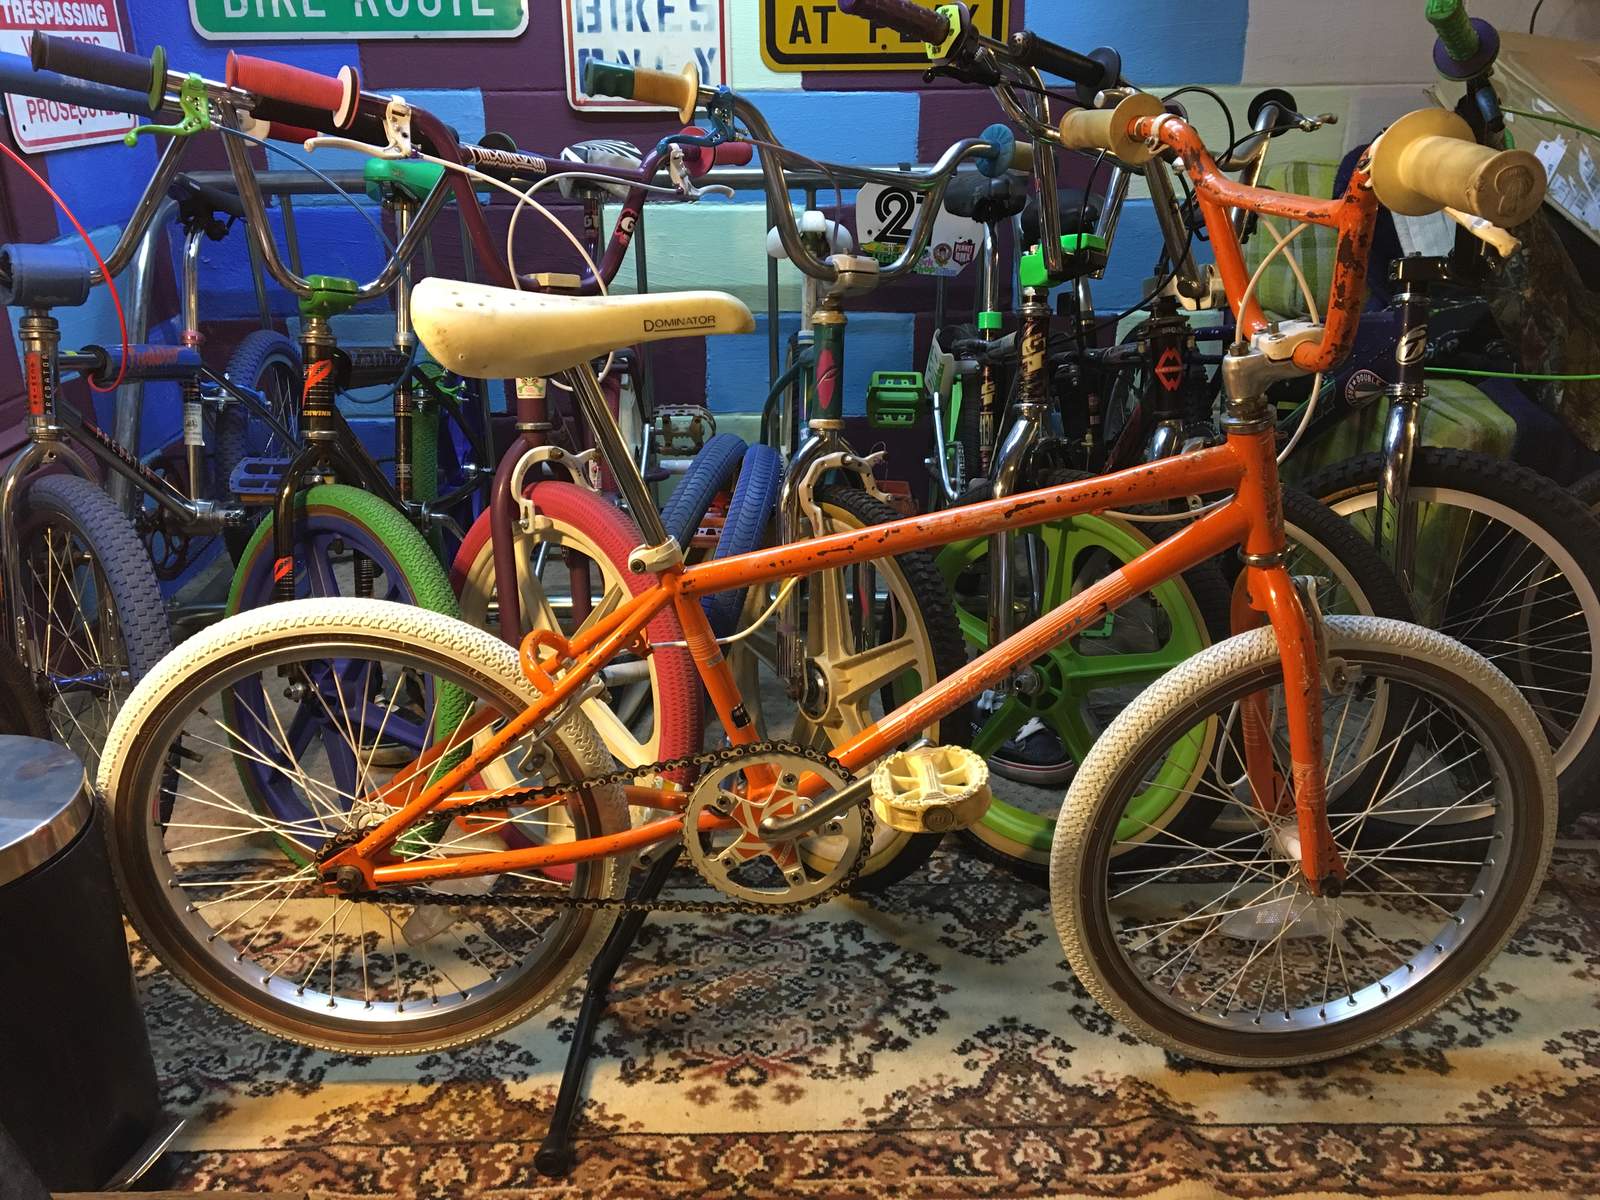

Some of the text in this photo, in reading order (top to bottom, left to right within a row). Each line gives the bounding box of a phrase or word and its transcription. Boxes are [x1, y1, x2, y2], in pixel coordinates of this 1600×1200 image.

[1, 1, 109, 27] TRESPASSING
[576, 0, 717, 33] BIKES
[788, 5, 837, 44] AT
[643, 314, 717, 333] DOMINATOR
[41, 353, 53, 415] PREDATOR
